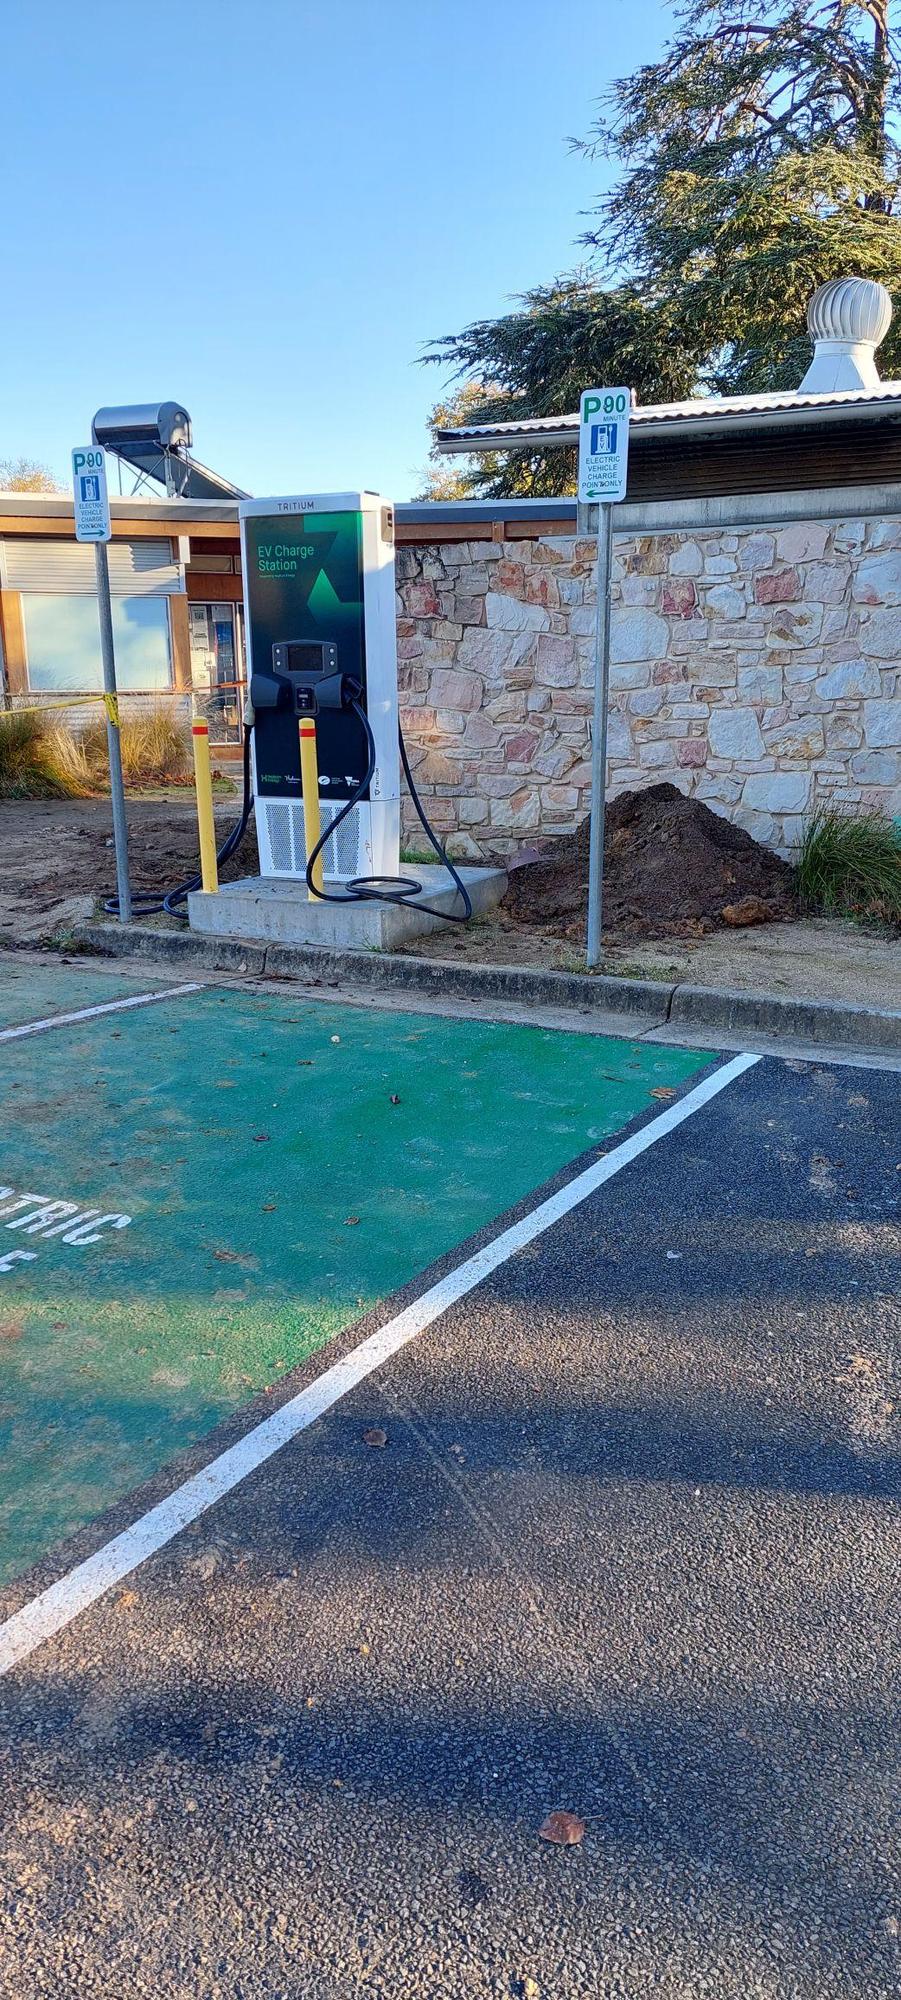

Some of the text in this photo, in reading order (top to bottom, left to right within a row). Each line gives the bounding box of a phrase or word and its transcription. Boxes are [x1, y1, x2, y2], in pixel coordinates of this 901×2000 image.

[586, 456, 621, 465] ELECTRIC
[588, 464, 618, 472] VEHICLE
[588, 472, 618, 480] CHARGE
[277, 501, 314, 511] TRITIUM
[258, 545, 315, 559] EV Charge
[258, 559, 297, 572] Station
[0, 1186, 132, 1246] TRIC
